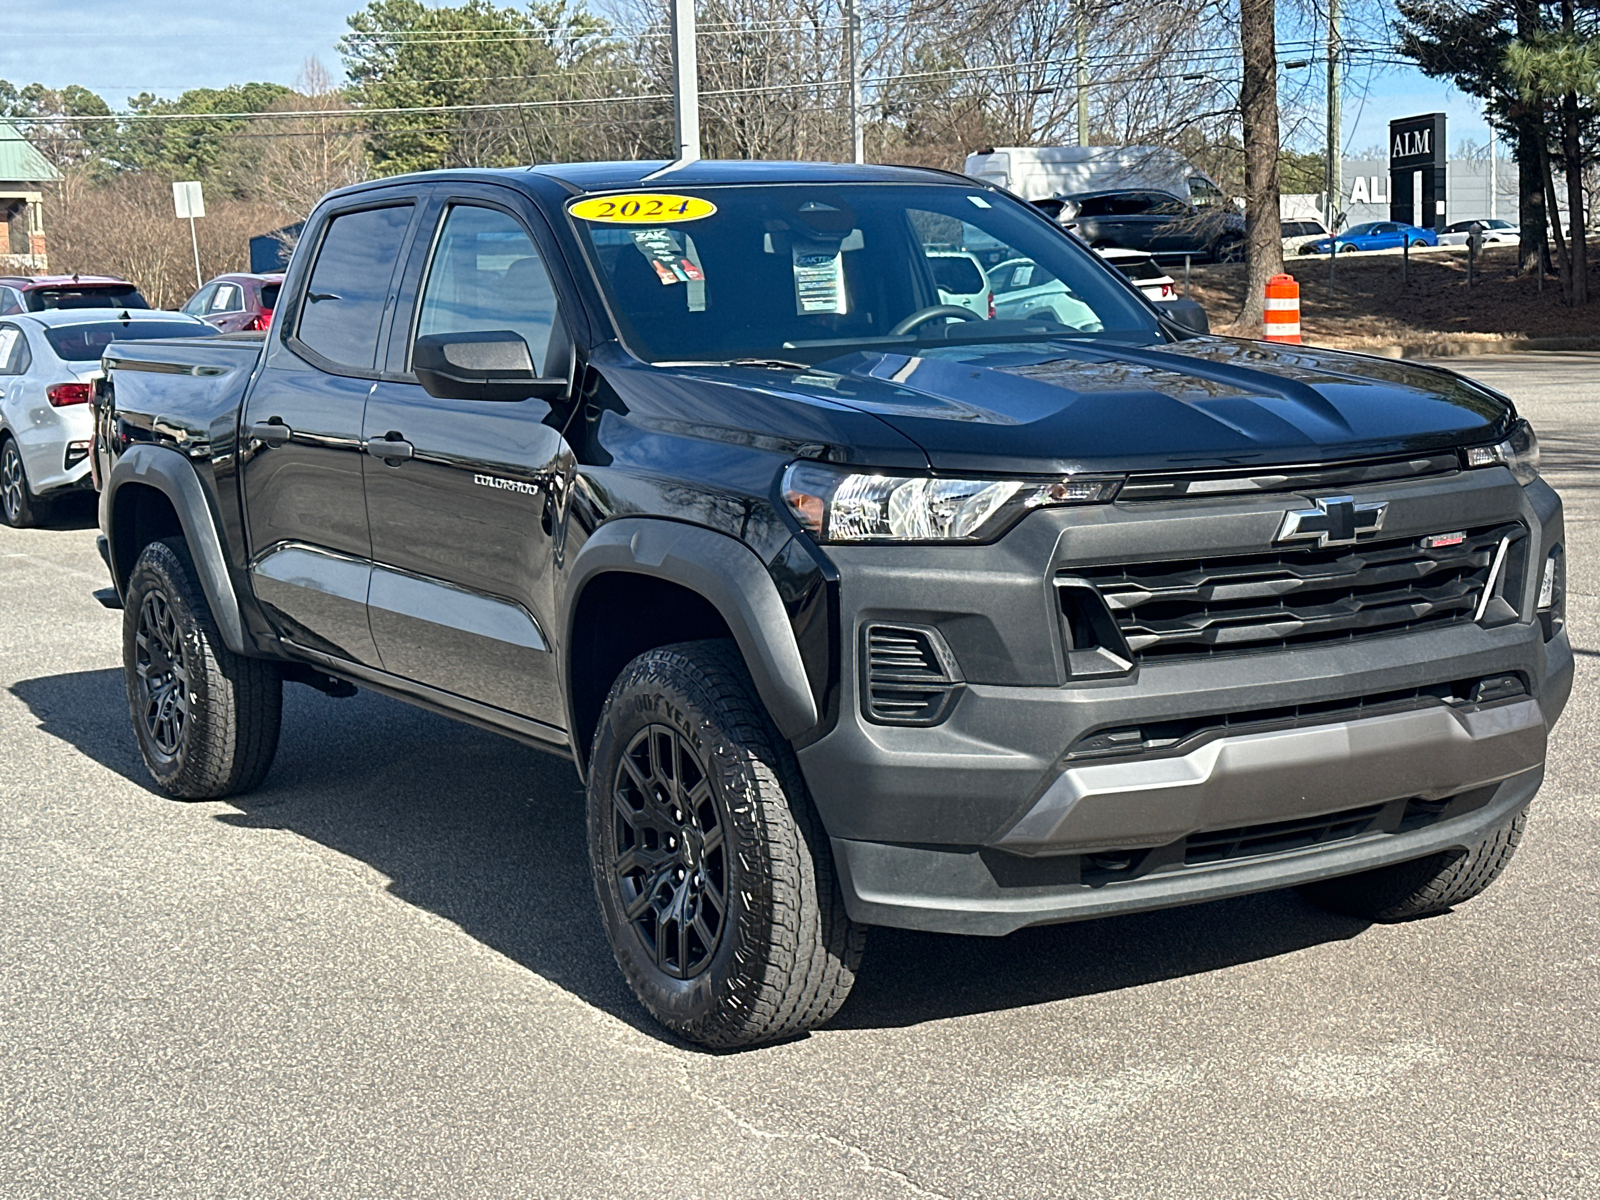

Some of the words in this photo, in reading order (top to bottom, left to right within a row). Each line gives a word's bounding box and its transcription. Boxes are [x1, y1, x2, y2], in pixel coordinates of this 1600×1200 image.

[1392, 128, 1431, 158] ALM
[596, 200, 690, 218] 2024
[474, 474, 539, 496] COLORADO
[617, 692, 703, 751] GOODYEAR
